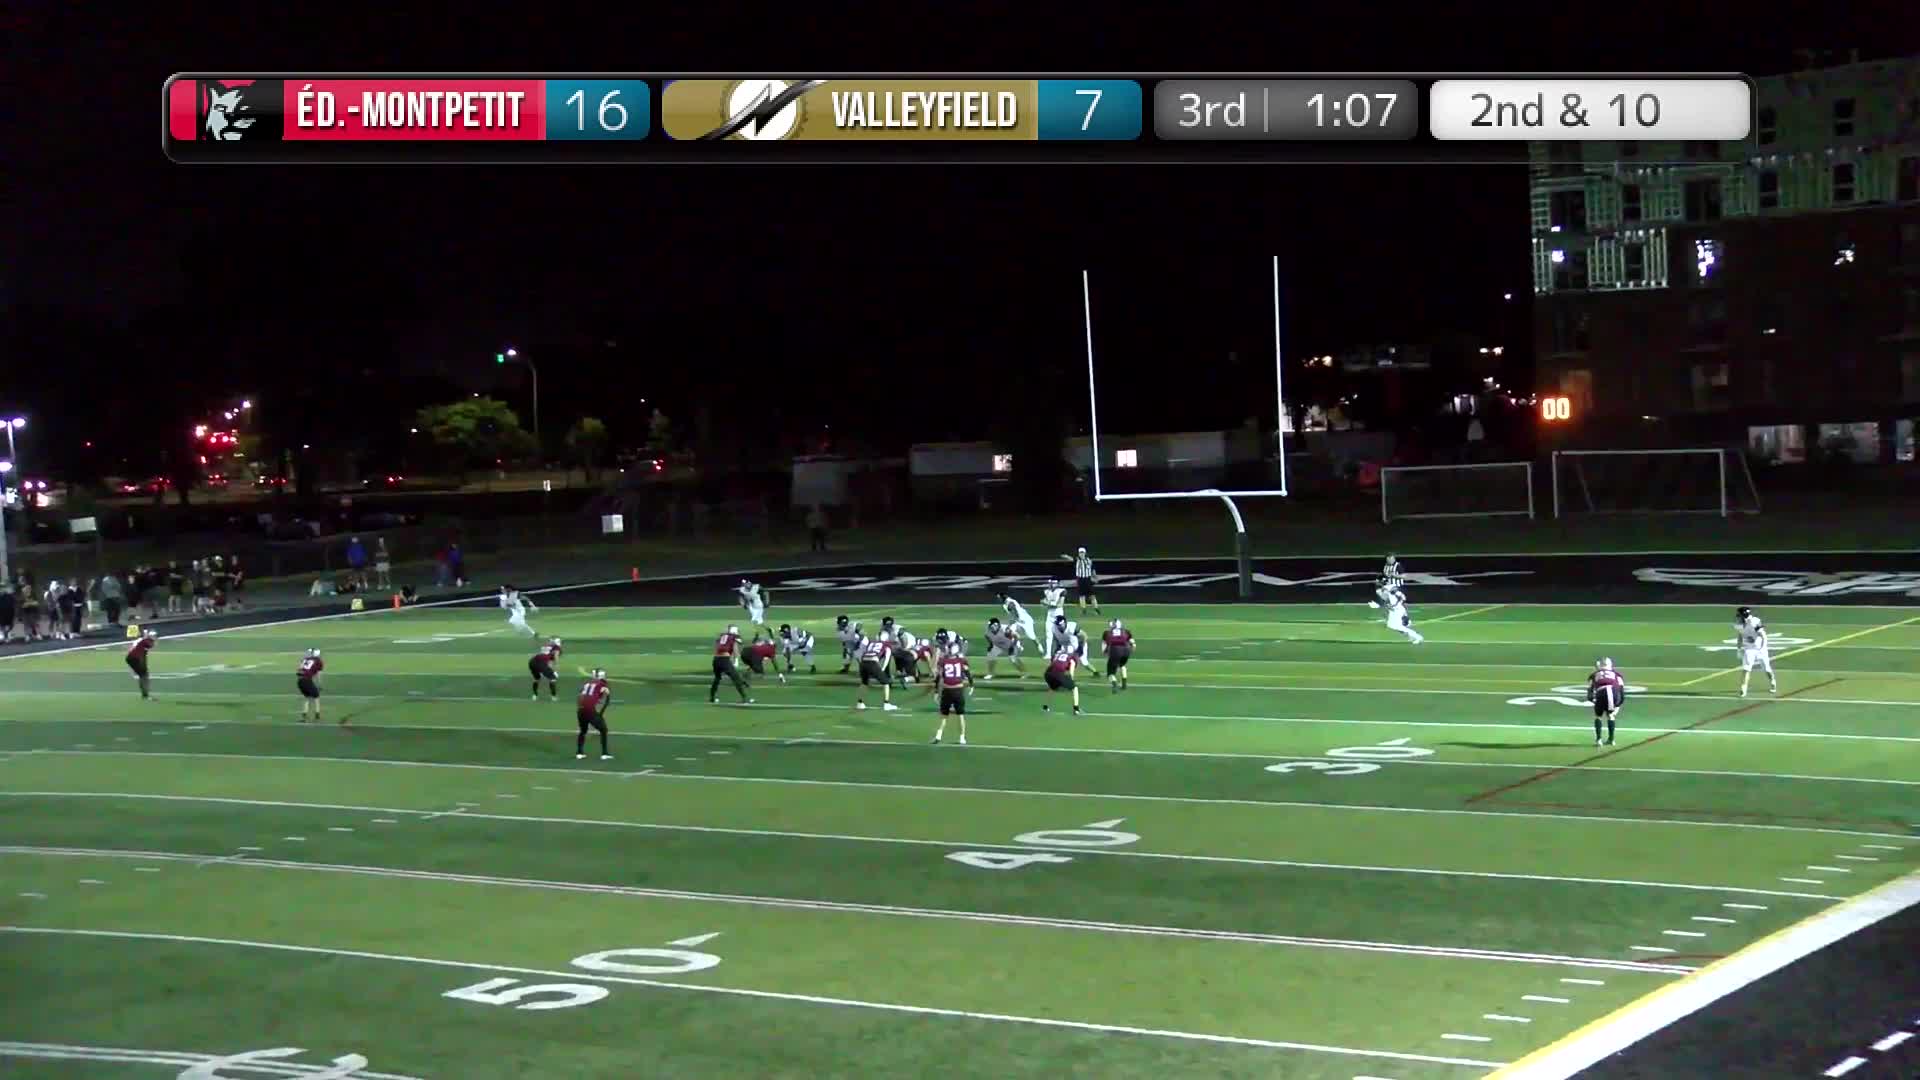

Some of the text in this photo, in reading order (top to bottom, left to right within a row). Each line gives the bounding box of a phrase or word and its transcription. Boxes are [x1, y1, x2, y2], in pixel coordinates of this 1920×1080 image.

[1543, 398, 1570, 420] 00
[944, 663, 961, 678] 21
[1265, 742, 1436, 775] 30
[944, 828, 1141, 870] 40
[441, 948, 721, 1010] 50
